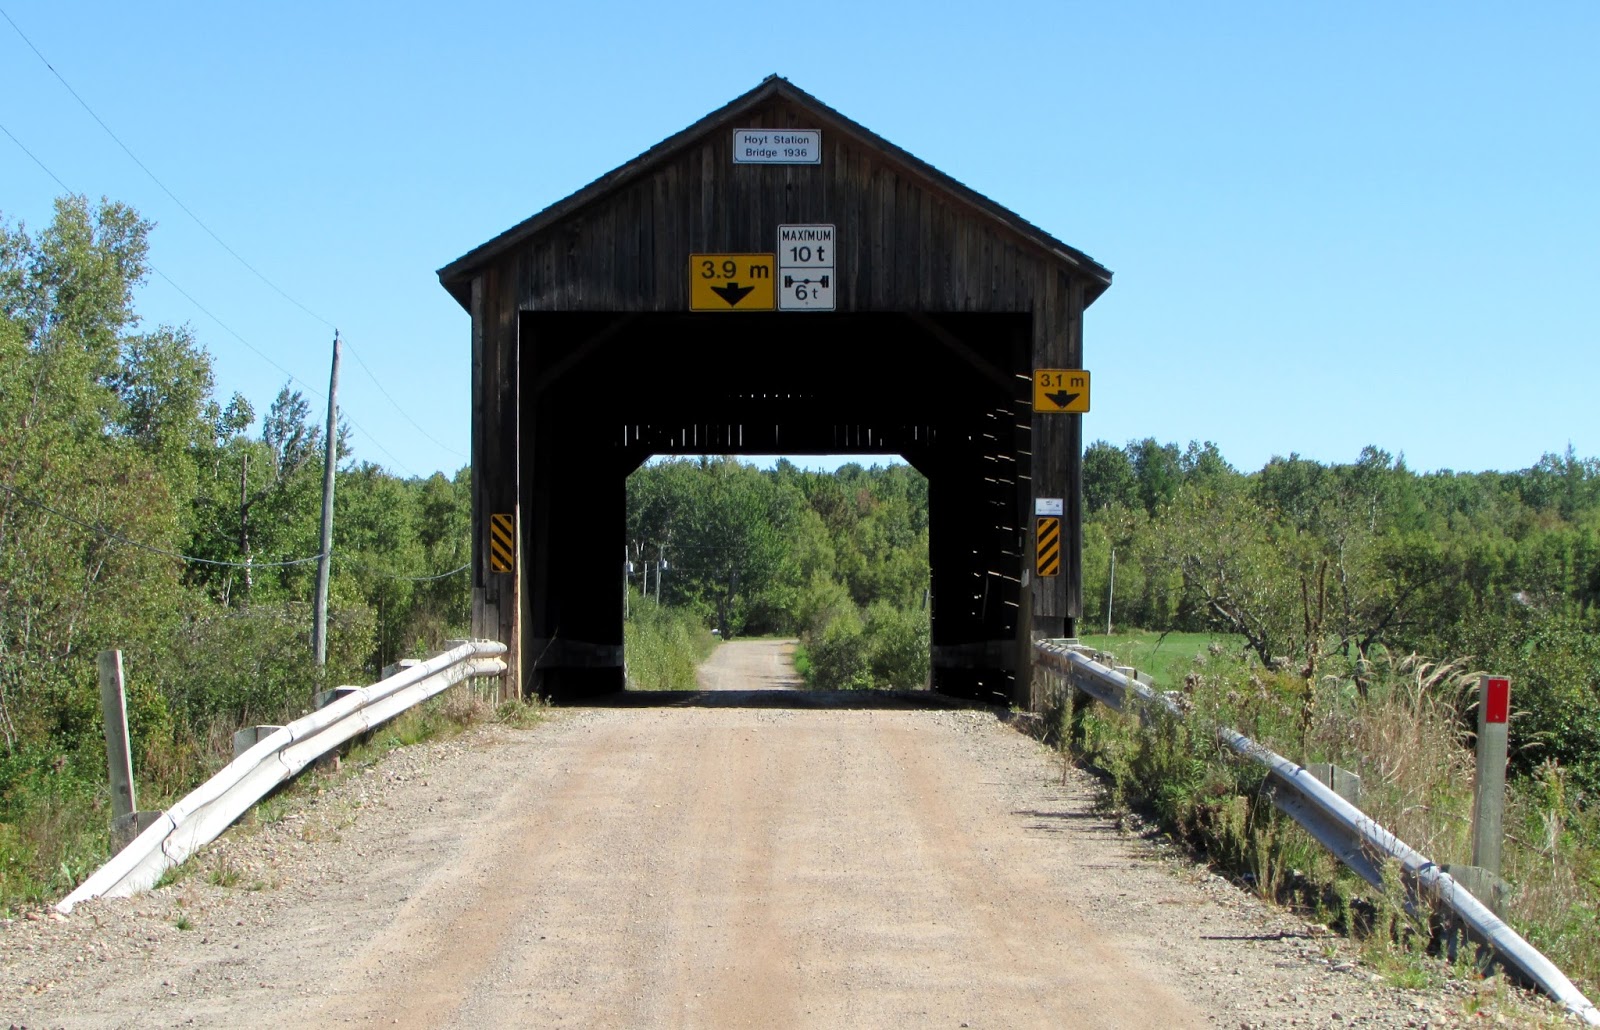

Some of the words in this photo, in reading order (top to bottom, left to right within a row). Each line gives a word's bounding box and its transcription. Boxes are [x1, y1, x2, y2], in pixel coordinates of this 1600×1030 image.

[744, 135, 768, 146] Hoyt
[773, 135, 810, 145] Station
[745, 148, 778, 158] Bridge
[783, 148, 808, 157] 1936
[782, 230, 831, 242] MAXIMUM
[790, 246, 812, 263] 10
[816, 246, 825, 262] t
[701, 260, 737, 279] 3.9
[749, 264, 769, 279] m
[795, 285, 808, 301] 6
[811, 288, 819, 300] t
[1041, 374, 1063, 387] 3.1
[1070, 377, 1084, 388] m
